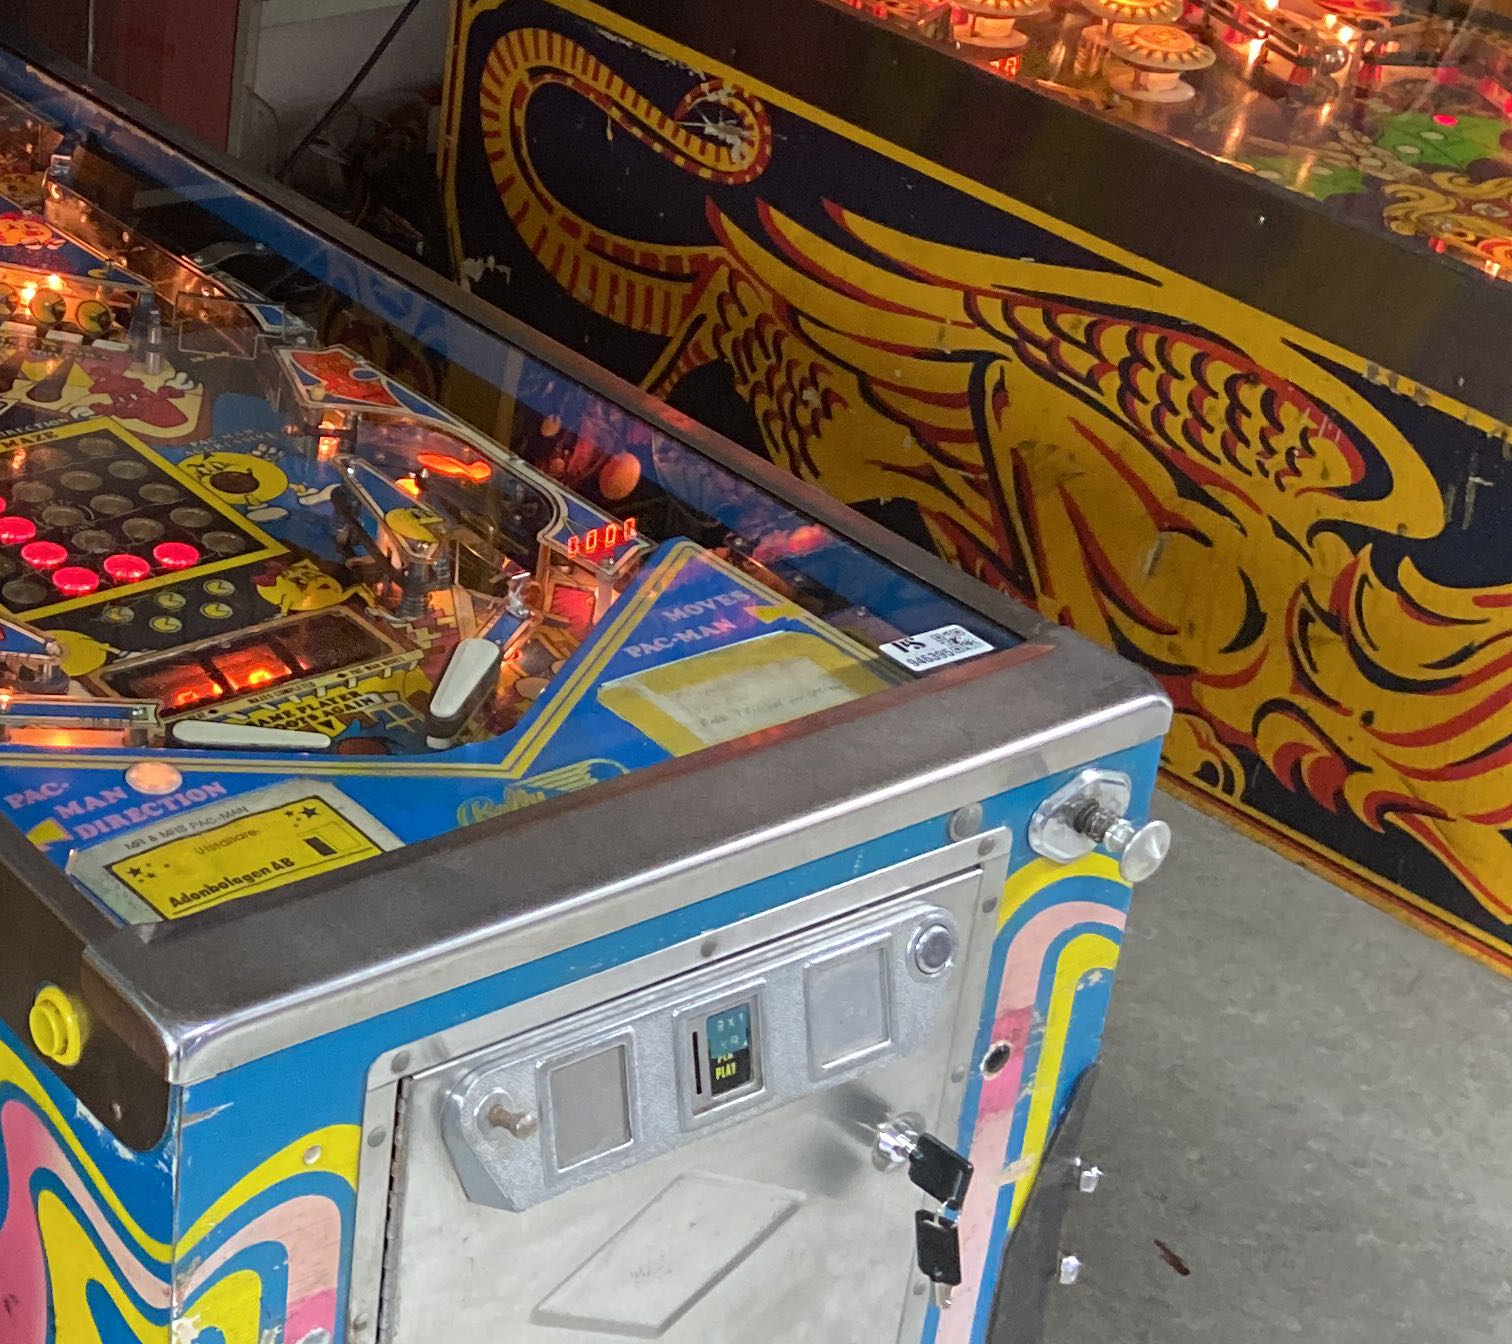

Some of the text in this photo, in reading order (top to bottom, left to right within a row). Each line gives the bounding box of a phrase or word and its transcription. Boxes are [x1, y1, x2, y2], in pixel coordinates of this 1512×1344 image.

[0, 430, 60, 449] MAZE
[661, 589, 752, 623] MOVES
[623, 617, 738, 658] PAC-MAN
[906, 648, 956, 667] 946395
[293, 690, 364, 714] PLAYER
[321, 695, 377, 717] AGAIN
[53, 786, 129, 820] MAN
[72, 781, 228, 841] DIRECTION
[270, 856, 296, 873] AB
